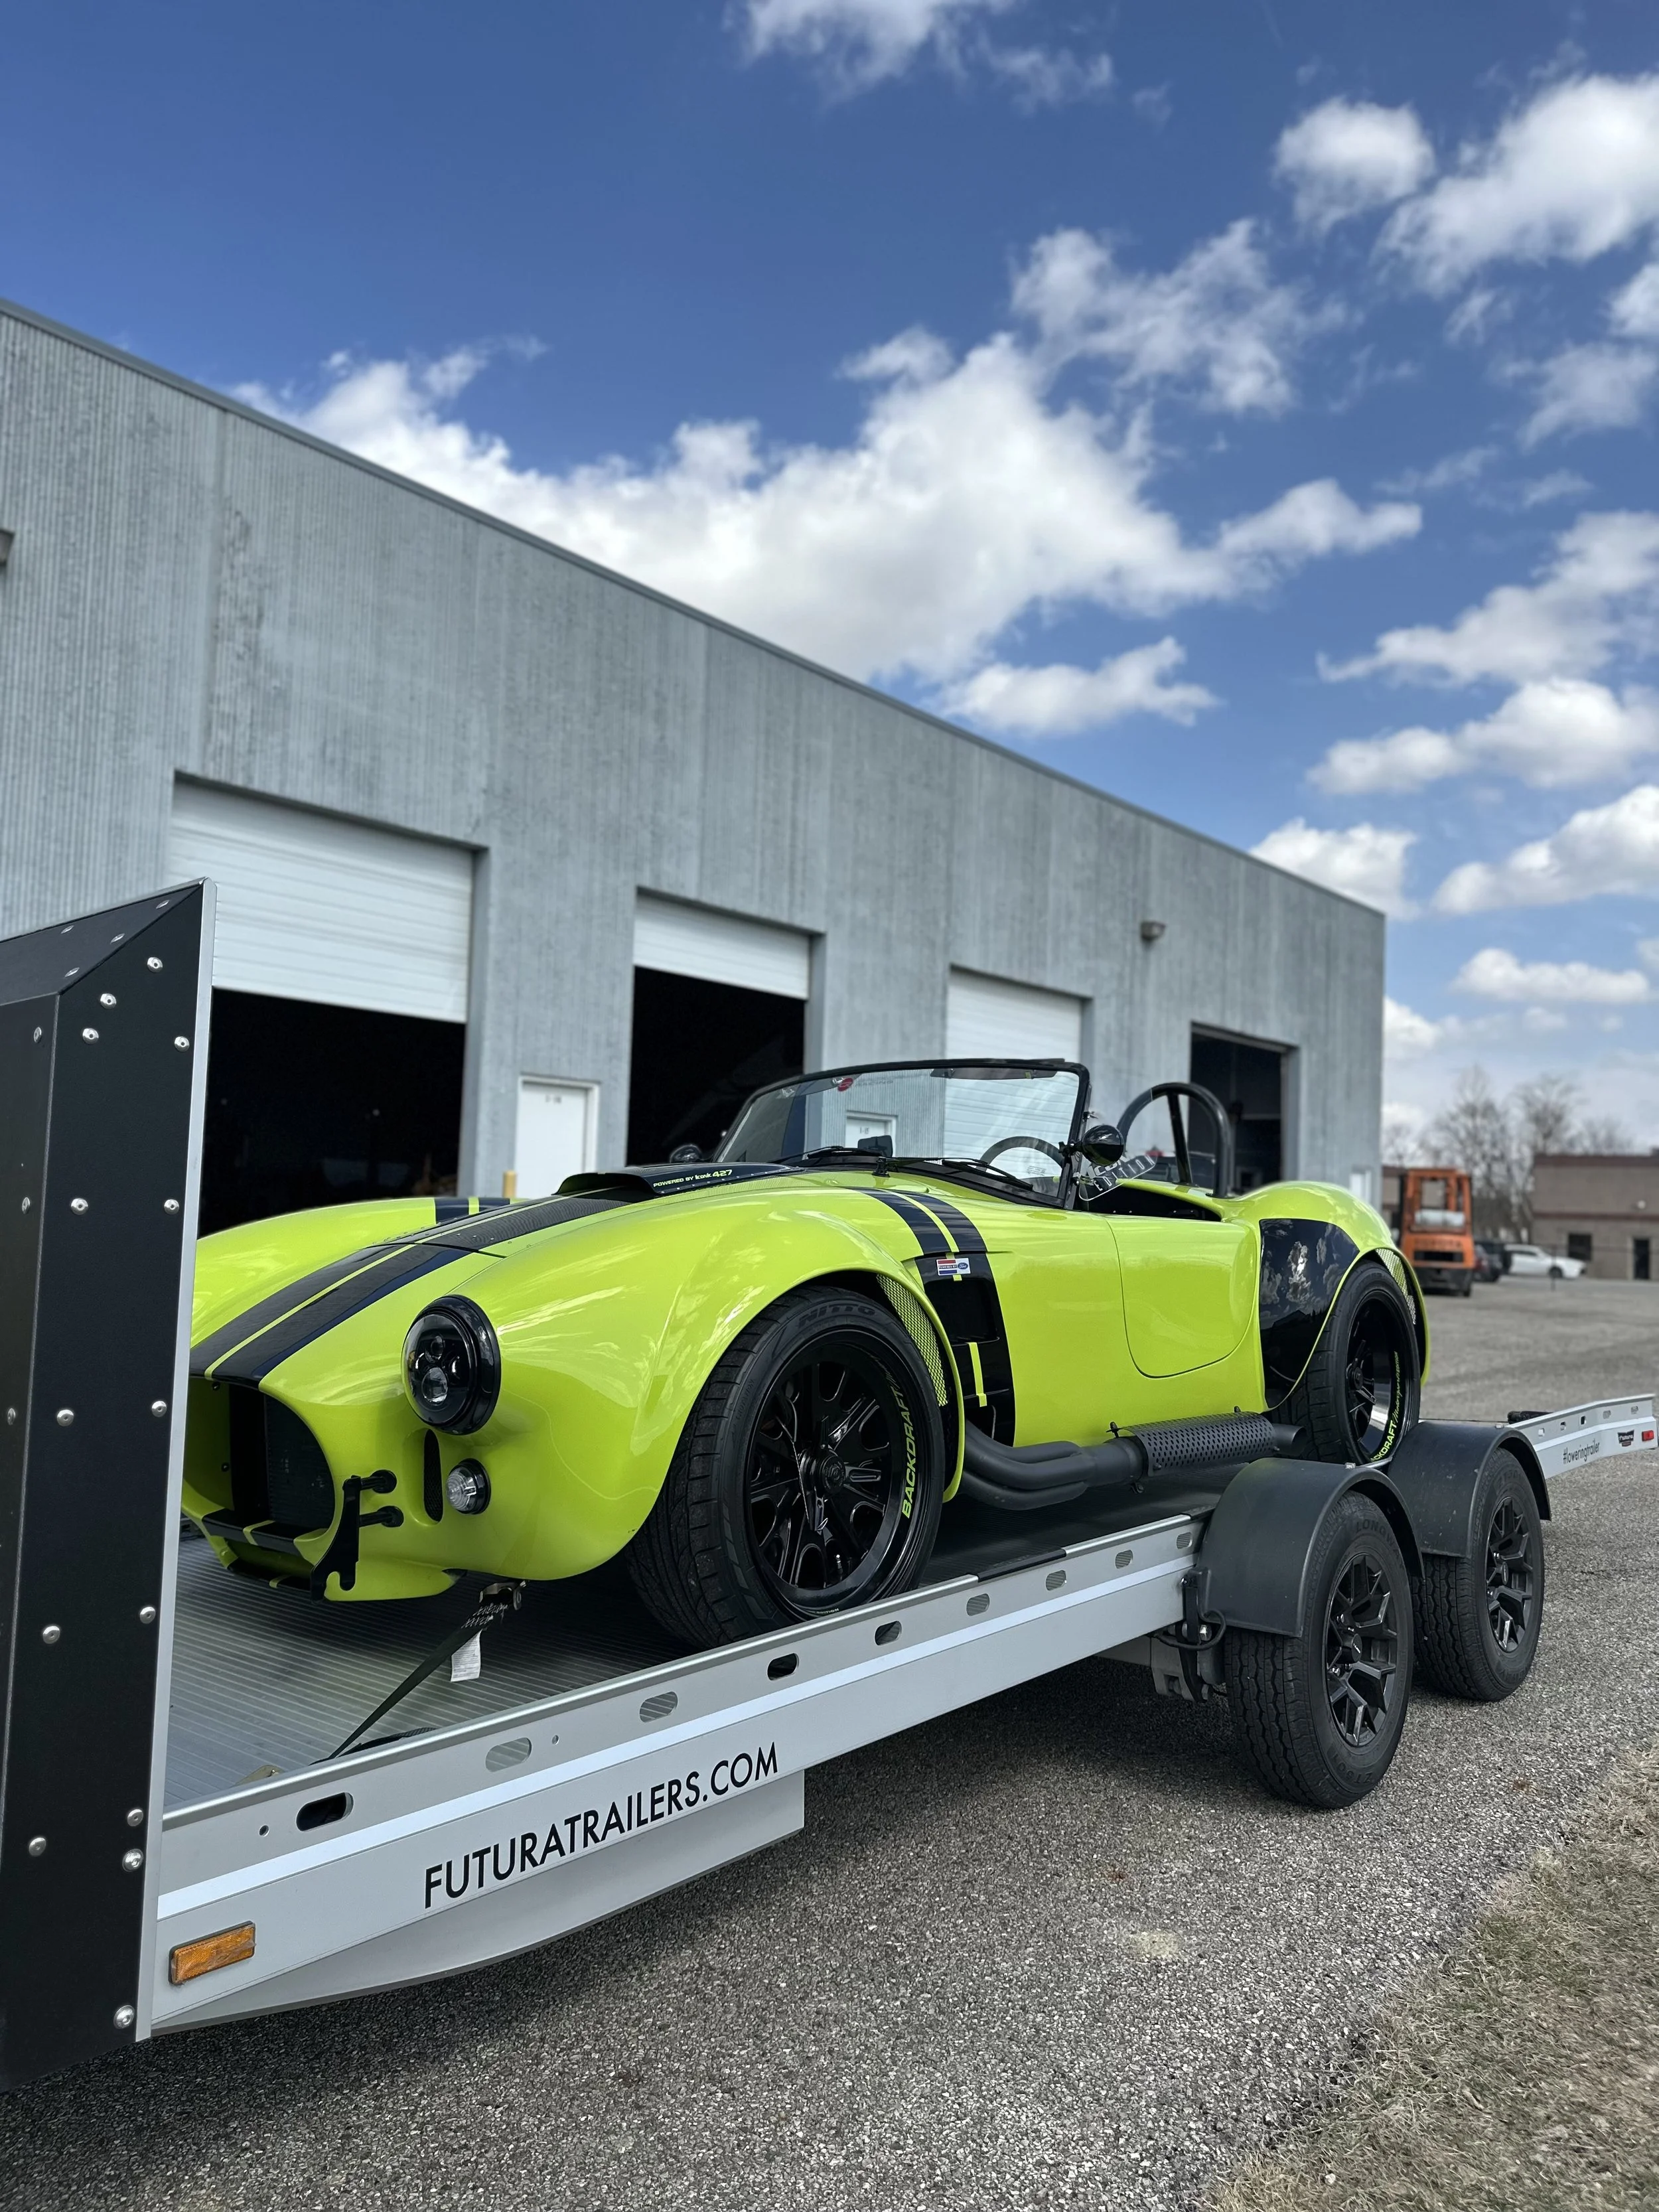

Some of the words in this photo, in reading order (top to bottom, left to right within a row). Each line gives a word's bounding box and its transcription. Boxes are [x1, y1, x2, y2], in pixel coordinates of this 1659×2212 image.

[653, 1177, 684, 1187] POWERED
[712, 1169, 733, 1177] 427
[1093, 1155, 1155, 1191] EDITION
[890, 1386, 917, 1520] BACKDRAFT
[1370, 1420, 1397, 1461] CKDRAFT
[1563, 1438, 1601, 1465] #loweringtrailer
[424, 1741, 778, 1909] FUTURATRAILERS.COM
